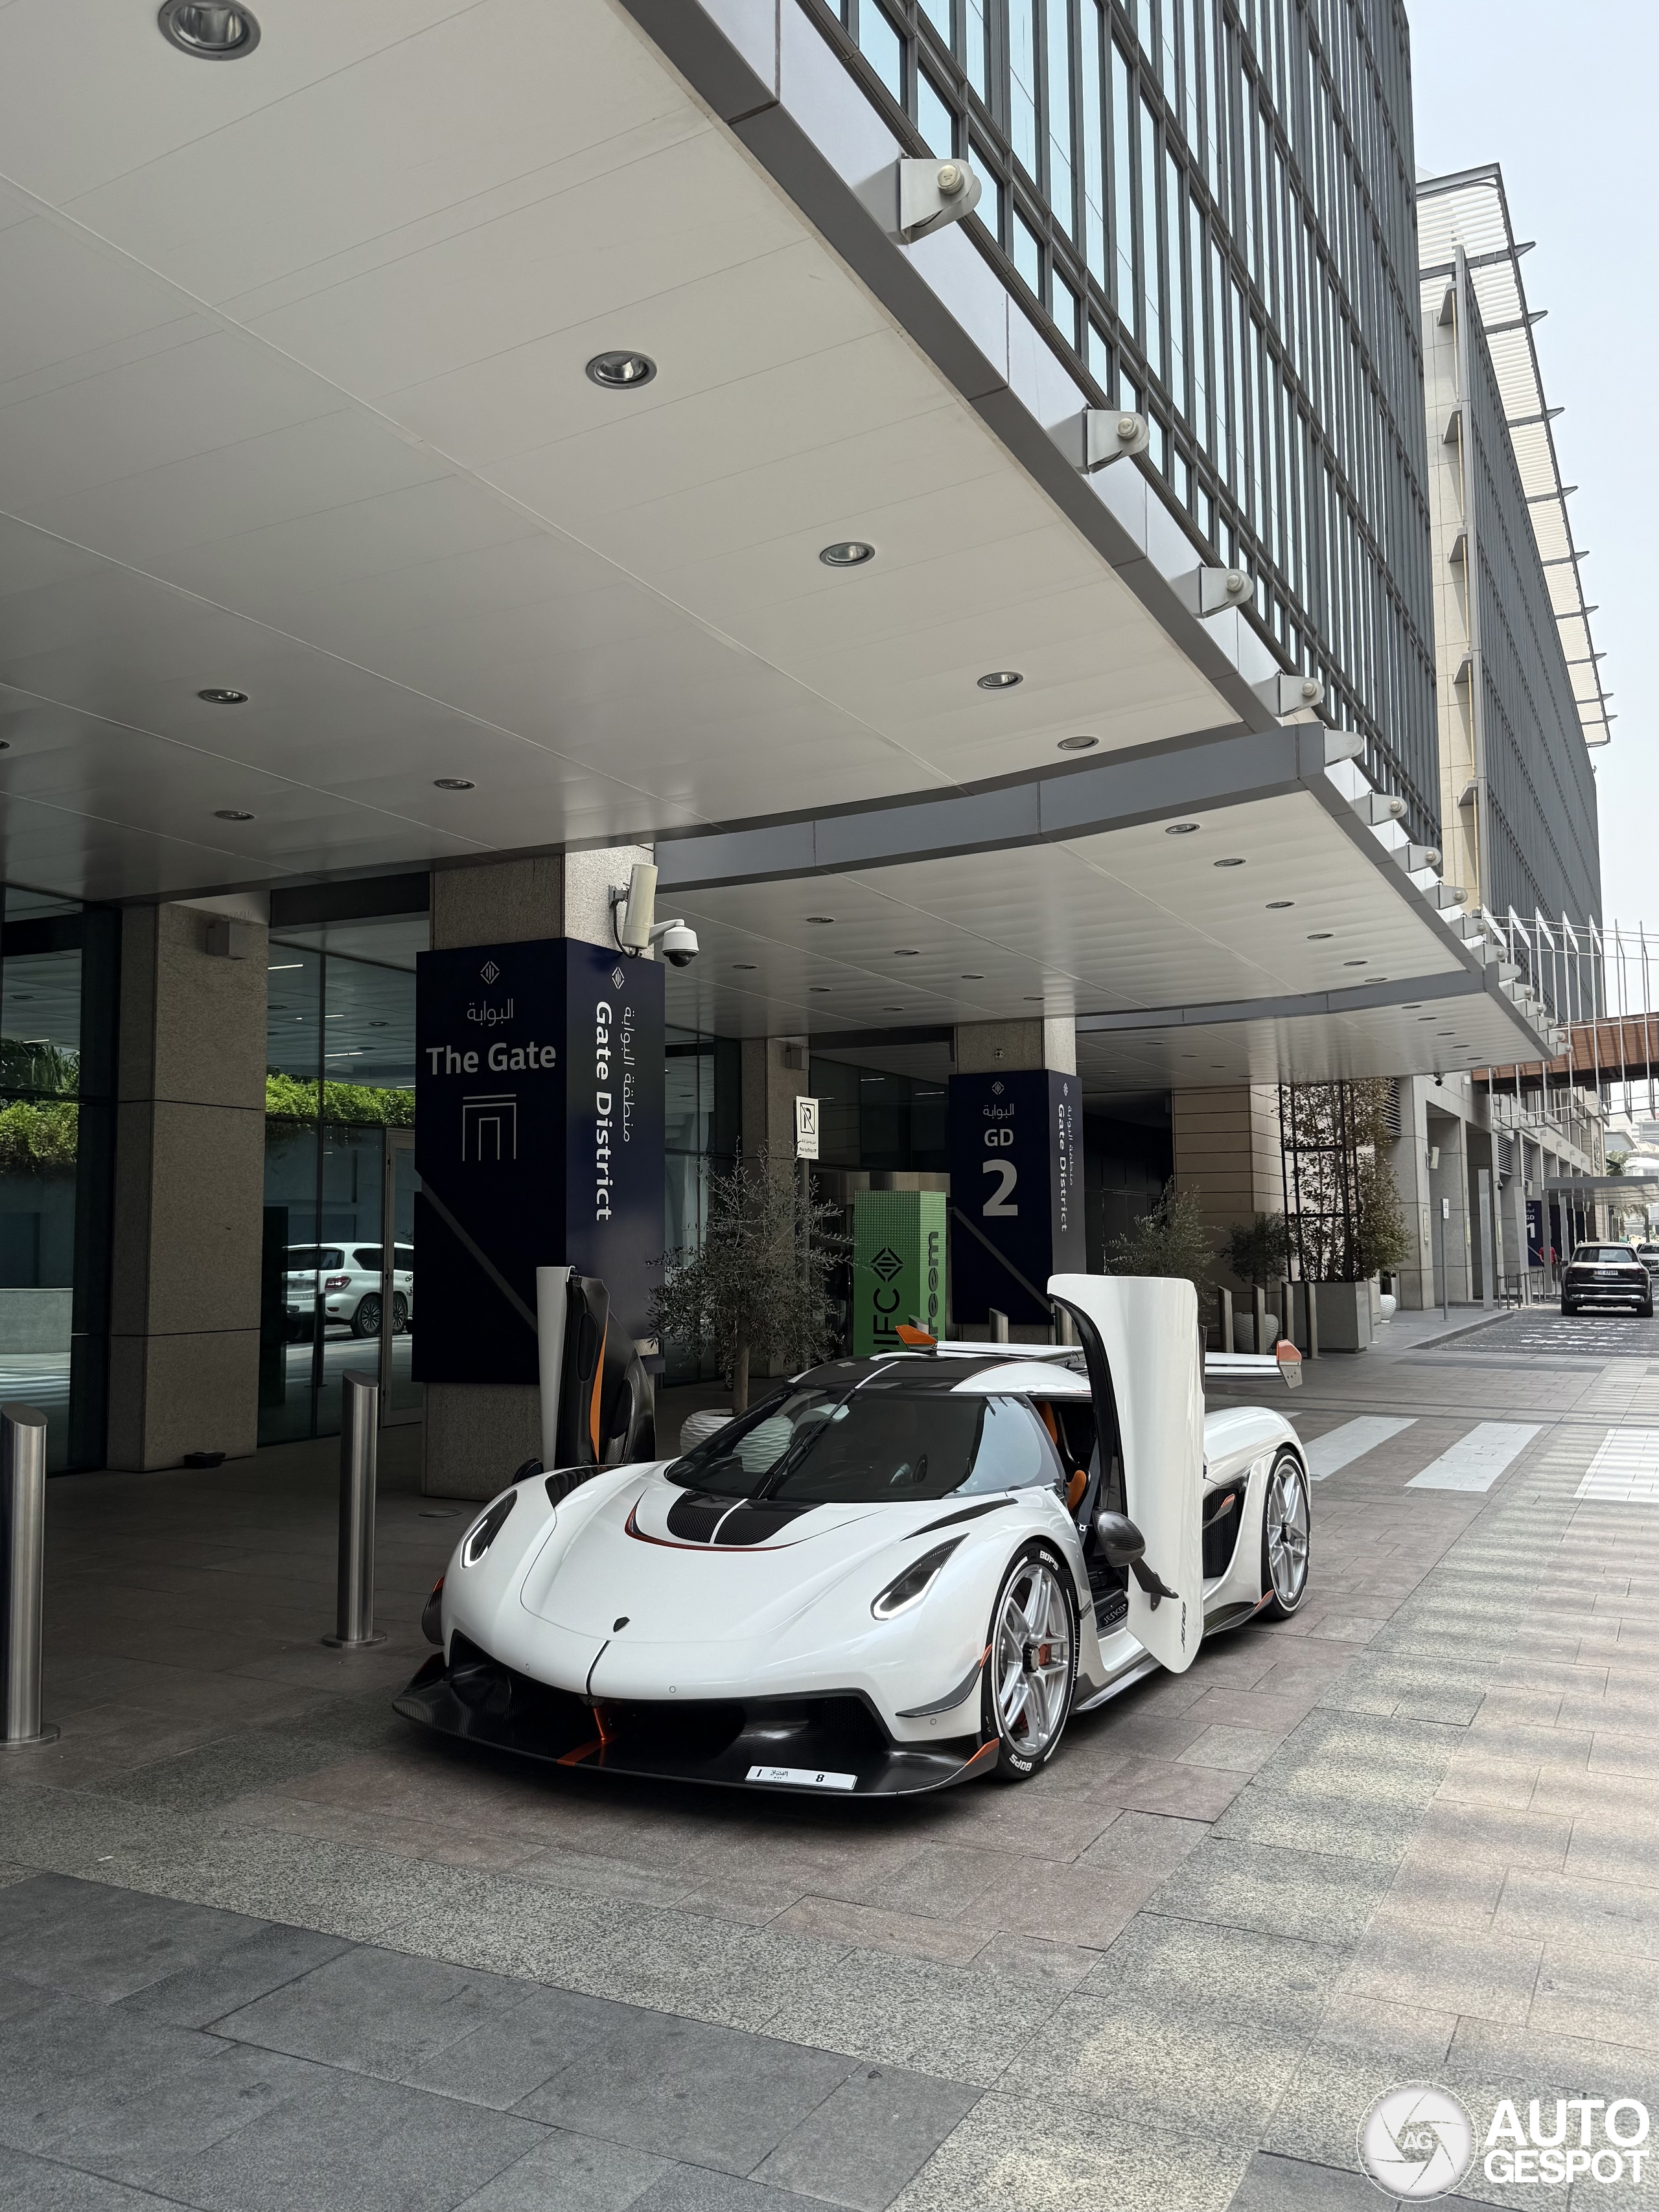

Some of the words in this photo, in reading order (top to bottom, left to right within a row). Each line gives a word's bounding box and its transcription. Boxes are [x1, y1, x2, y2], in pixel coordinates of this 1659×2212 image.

[467, 998, 514, 1027] البوابة
[596, 1001, 612, 1081] Gate
[620, 1006, 636, 1066] البوابة
[426, 1044, 479, 1075] The
[487, 1041, 557, 1072] Gate
[623, 1073, 636, 1142] منطقة
[982, 1103, 1015, 1120] البوابة
[596, 1091, 614, 1221] District
[984, 1128, 1014, 1147] GD
[982, 1159, 1018, 1216] 2
[1526, 1223, 1535, 1238] 1
[929, 1232, 939, 1341] reem
[873, 1287, 900, 1353] IFC
[1104, 1606, 1125, 1624] JESKO
